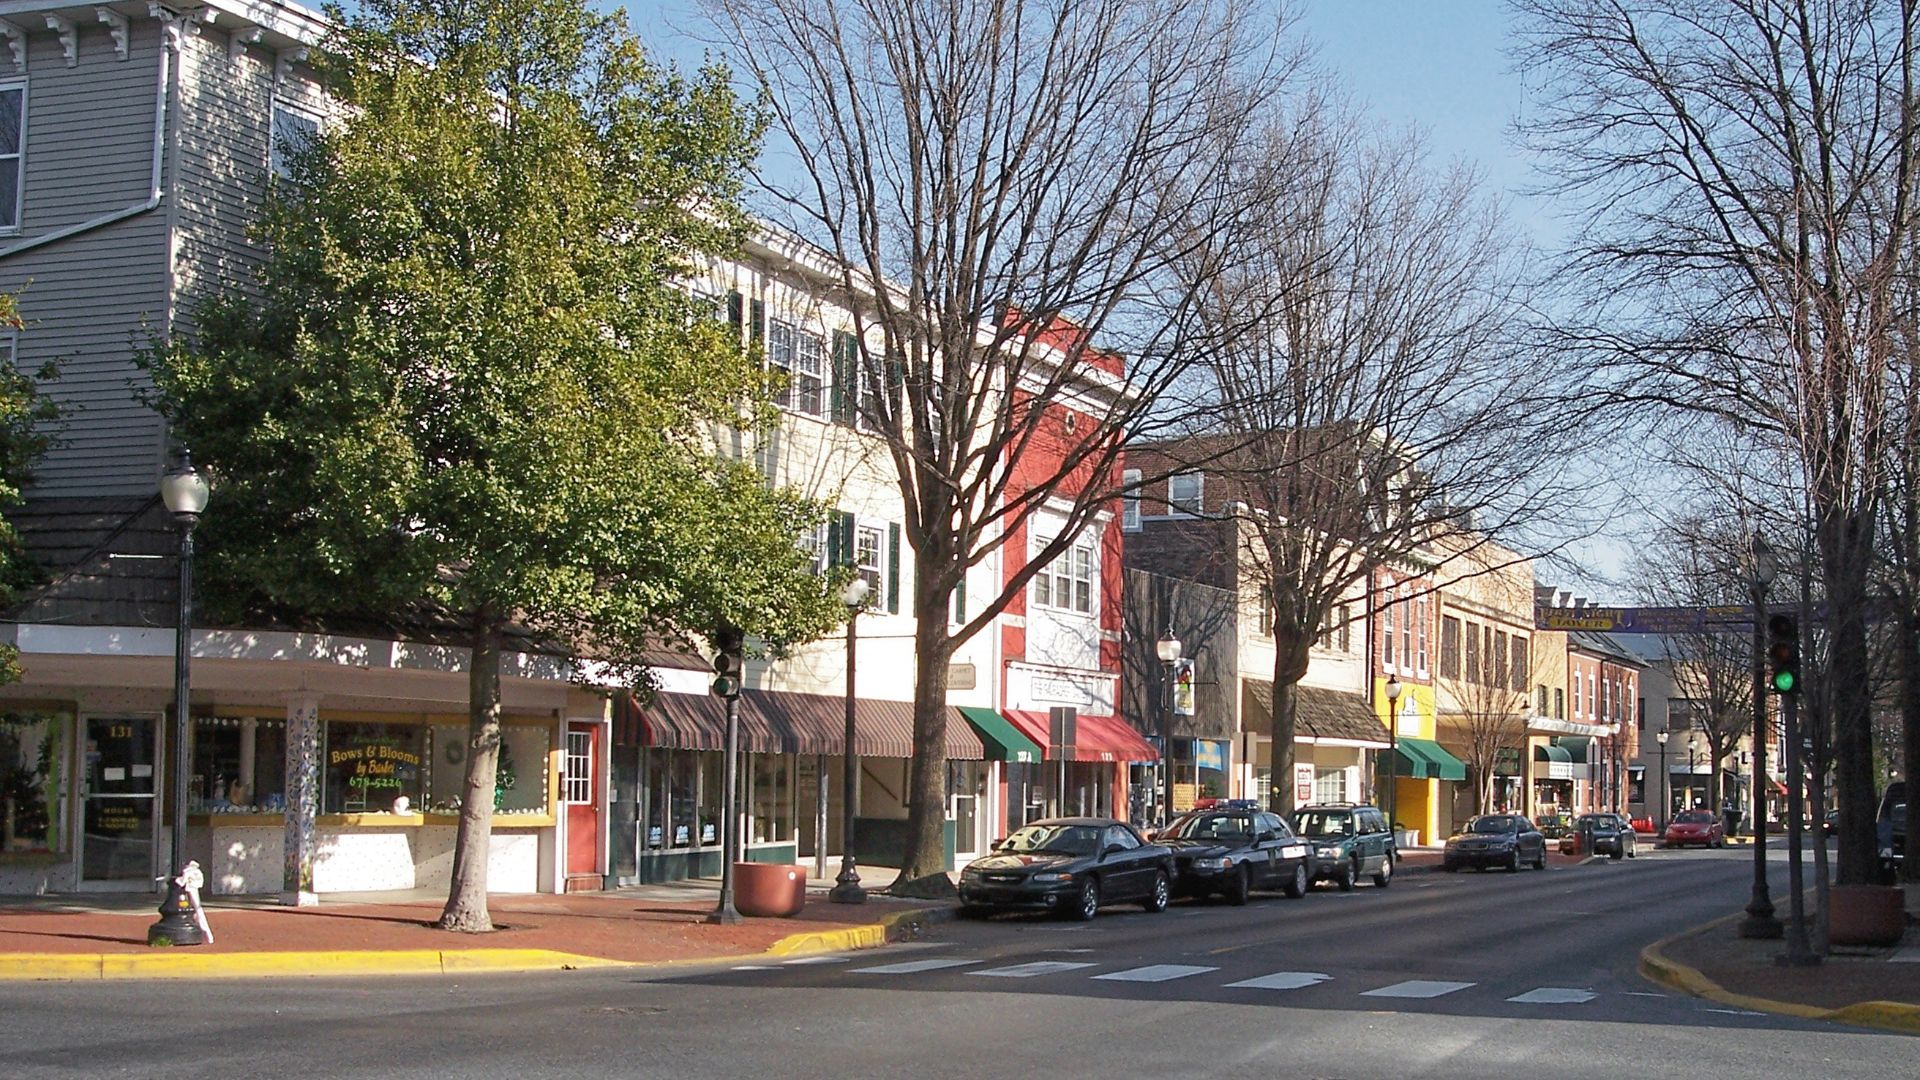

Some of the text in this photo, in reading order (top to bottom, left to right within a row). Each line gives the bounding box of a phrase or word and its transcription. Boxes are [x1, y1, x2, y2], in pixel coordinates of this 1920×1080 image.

[111, 726, 132, 737] 131
[332, 745, 420, 765] Bows & Blooms
[356, 760, 367, 777] by
[349, 777, 402, 788] 678-5226
